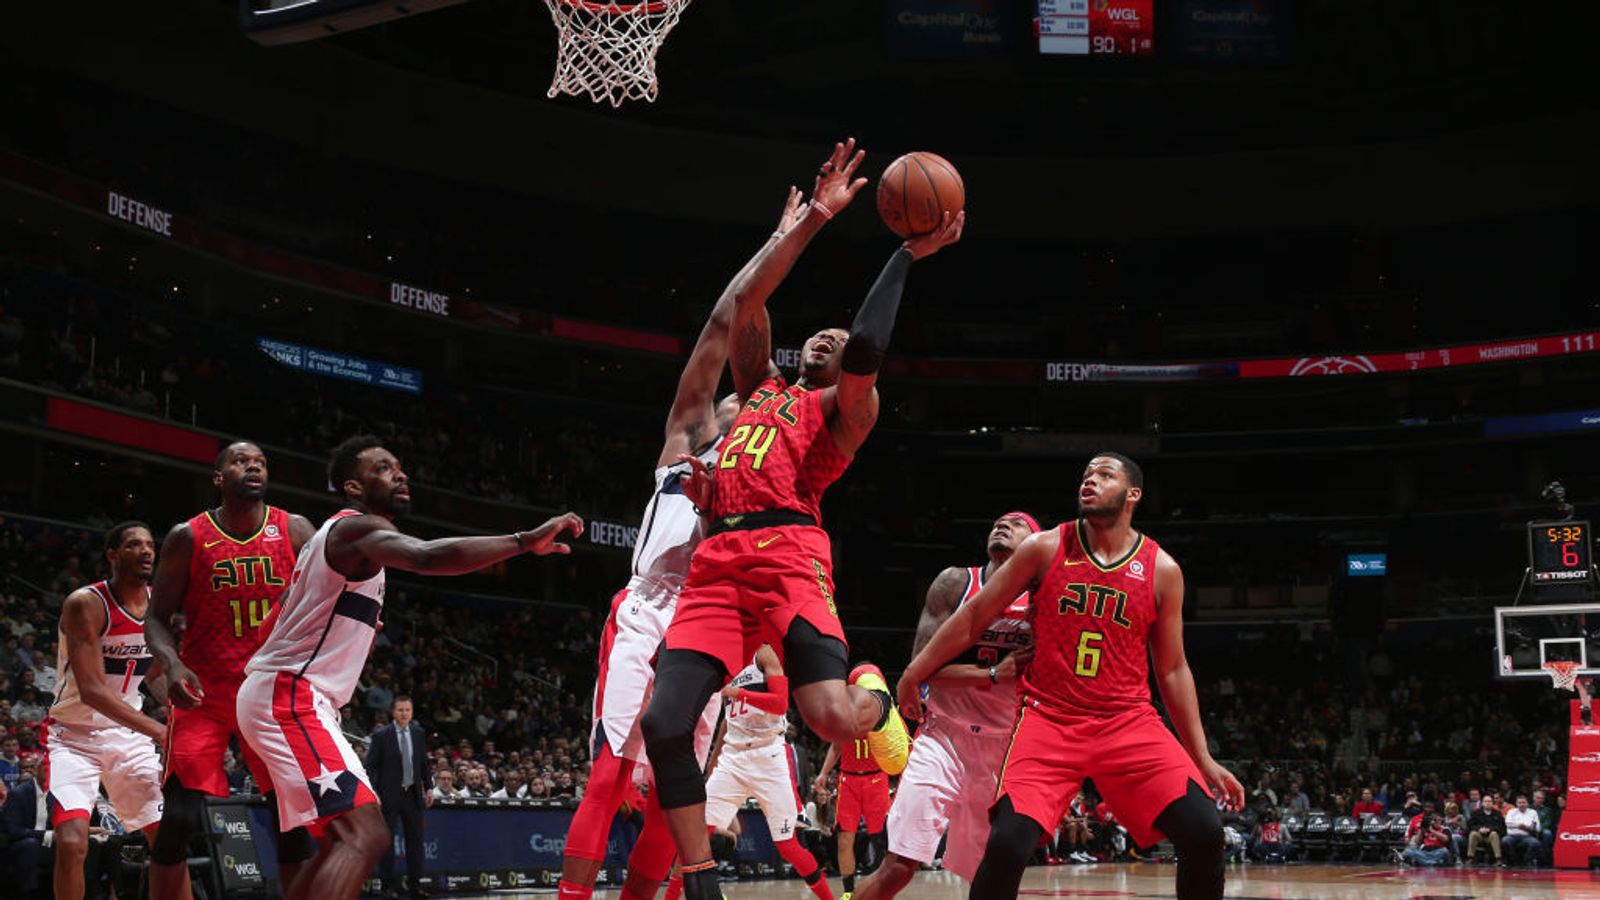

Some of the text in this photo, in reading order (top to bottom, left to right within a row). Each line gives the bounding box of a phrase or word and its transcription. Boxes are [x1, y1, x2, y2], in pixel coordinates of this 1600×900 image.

[1107, 8, 1140, 20] WGL
[108, 191, 172, 236] DEFENSE
[391, 282, 449, 316] DEFENSE
[1479, 343, 1538, 359] WASHINGTON
[1561, 336, 1594, 353] 111
[719, 423, 778, 472] 24
[1547, 526, 1582, 543] 5:32
[1562, 541, 1580, 568] 6
[211, 555, 286, 593] ATL
[1058, 582, 1132, 630] ATL
[1075, 630, 1104, 678] 6
[121, 659, 137, 695] 1
[854, 738, 869, 760] 11
[225, 821, 251, 835] WGL
[235, 862, 261, 875] WGL
